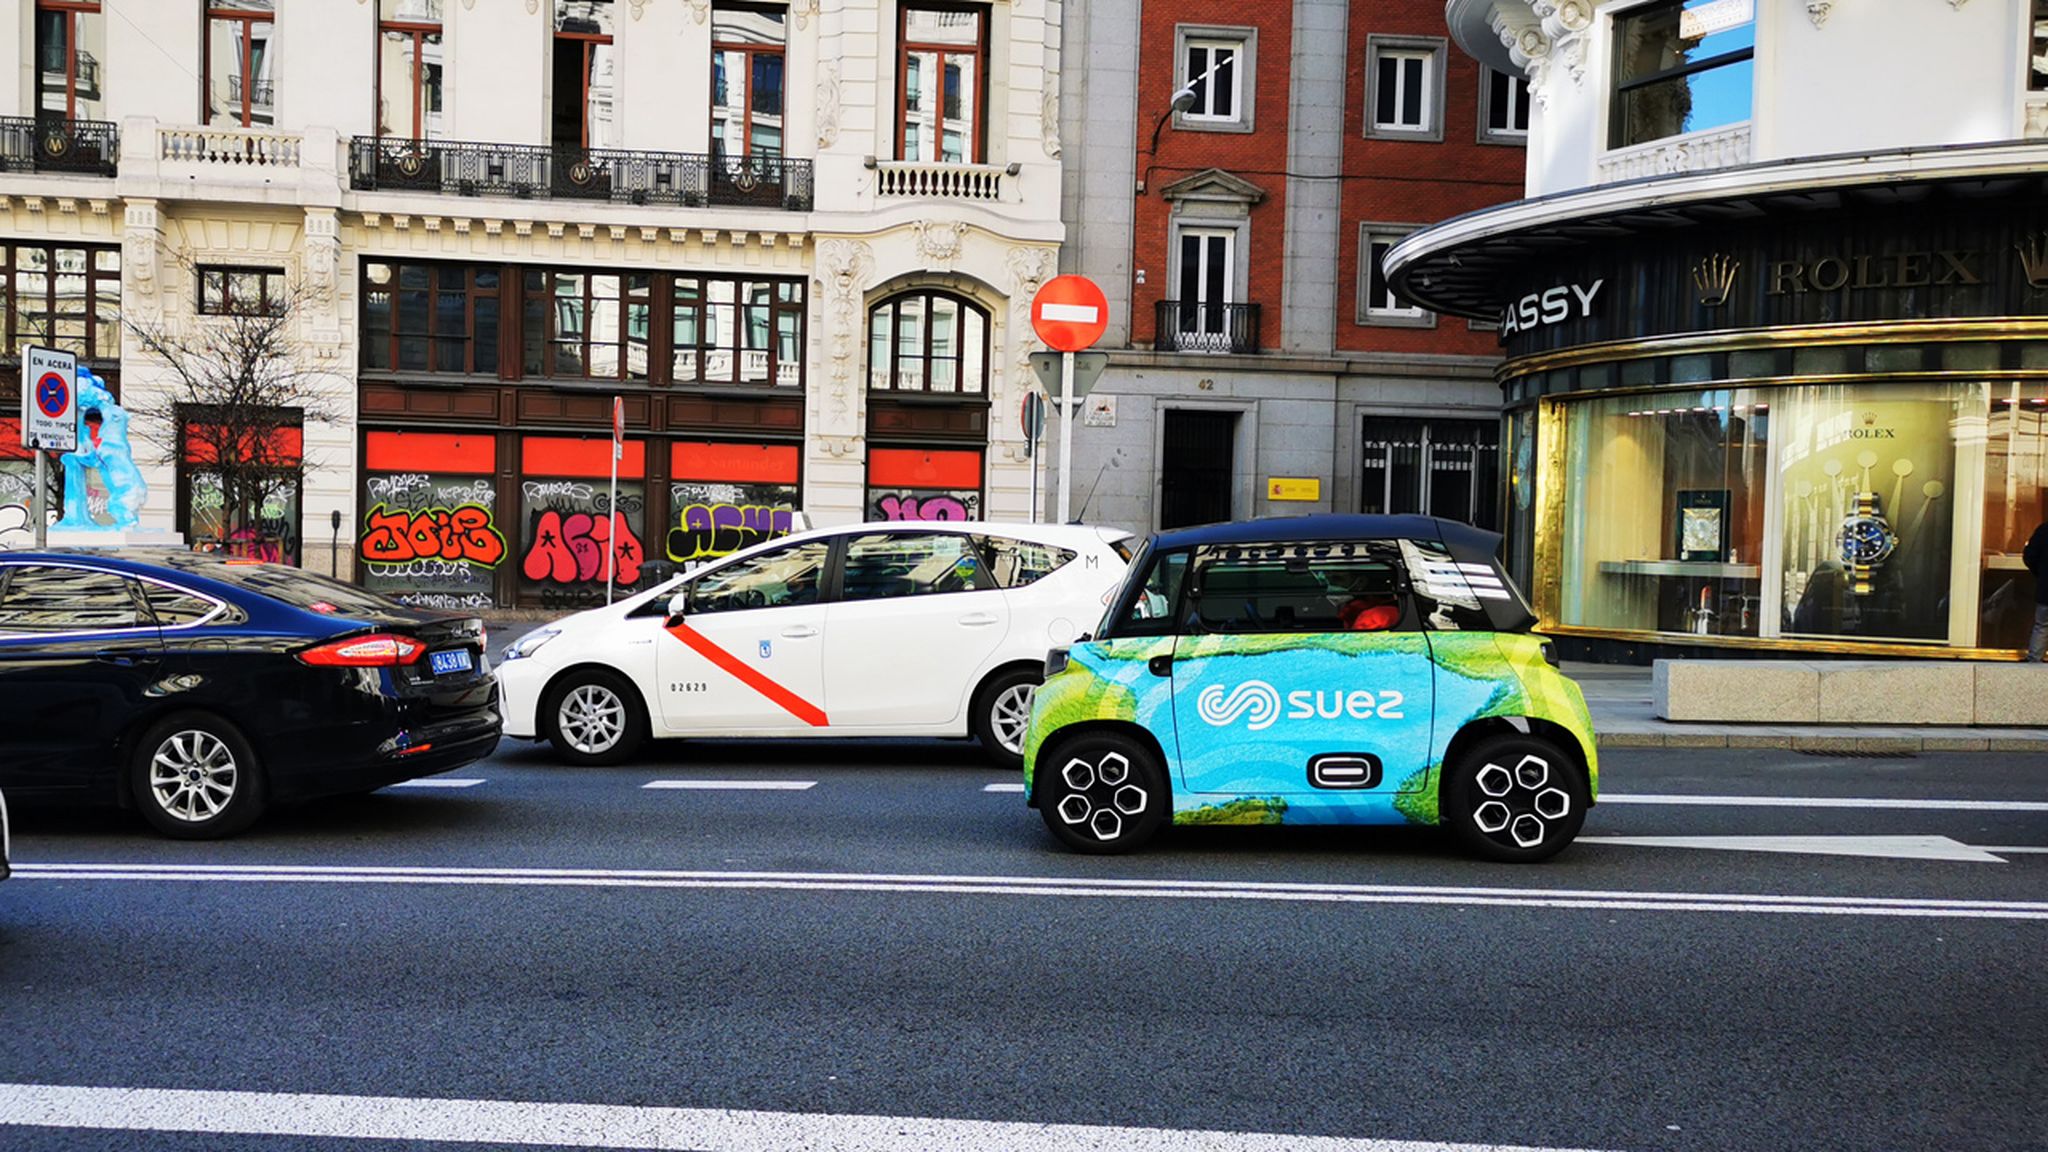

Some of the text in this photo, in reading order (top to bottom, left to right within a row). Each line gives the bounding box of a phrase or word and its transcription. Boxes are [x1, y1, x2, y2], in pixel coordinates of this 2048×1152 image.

[1766, 251, 1981, 295] ROLEX
[1500, 279, 1604, 337] ASSY
[32, 357, 72, 369] EN ACERA
[1086, 555, 1099, 569] M
[671, 682, 707, 692] 02629
[1287, 690, 1404, 719] suez
